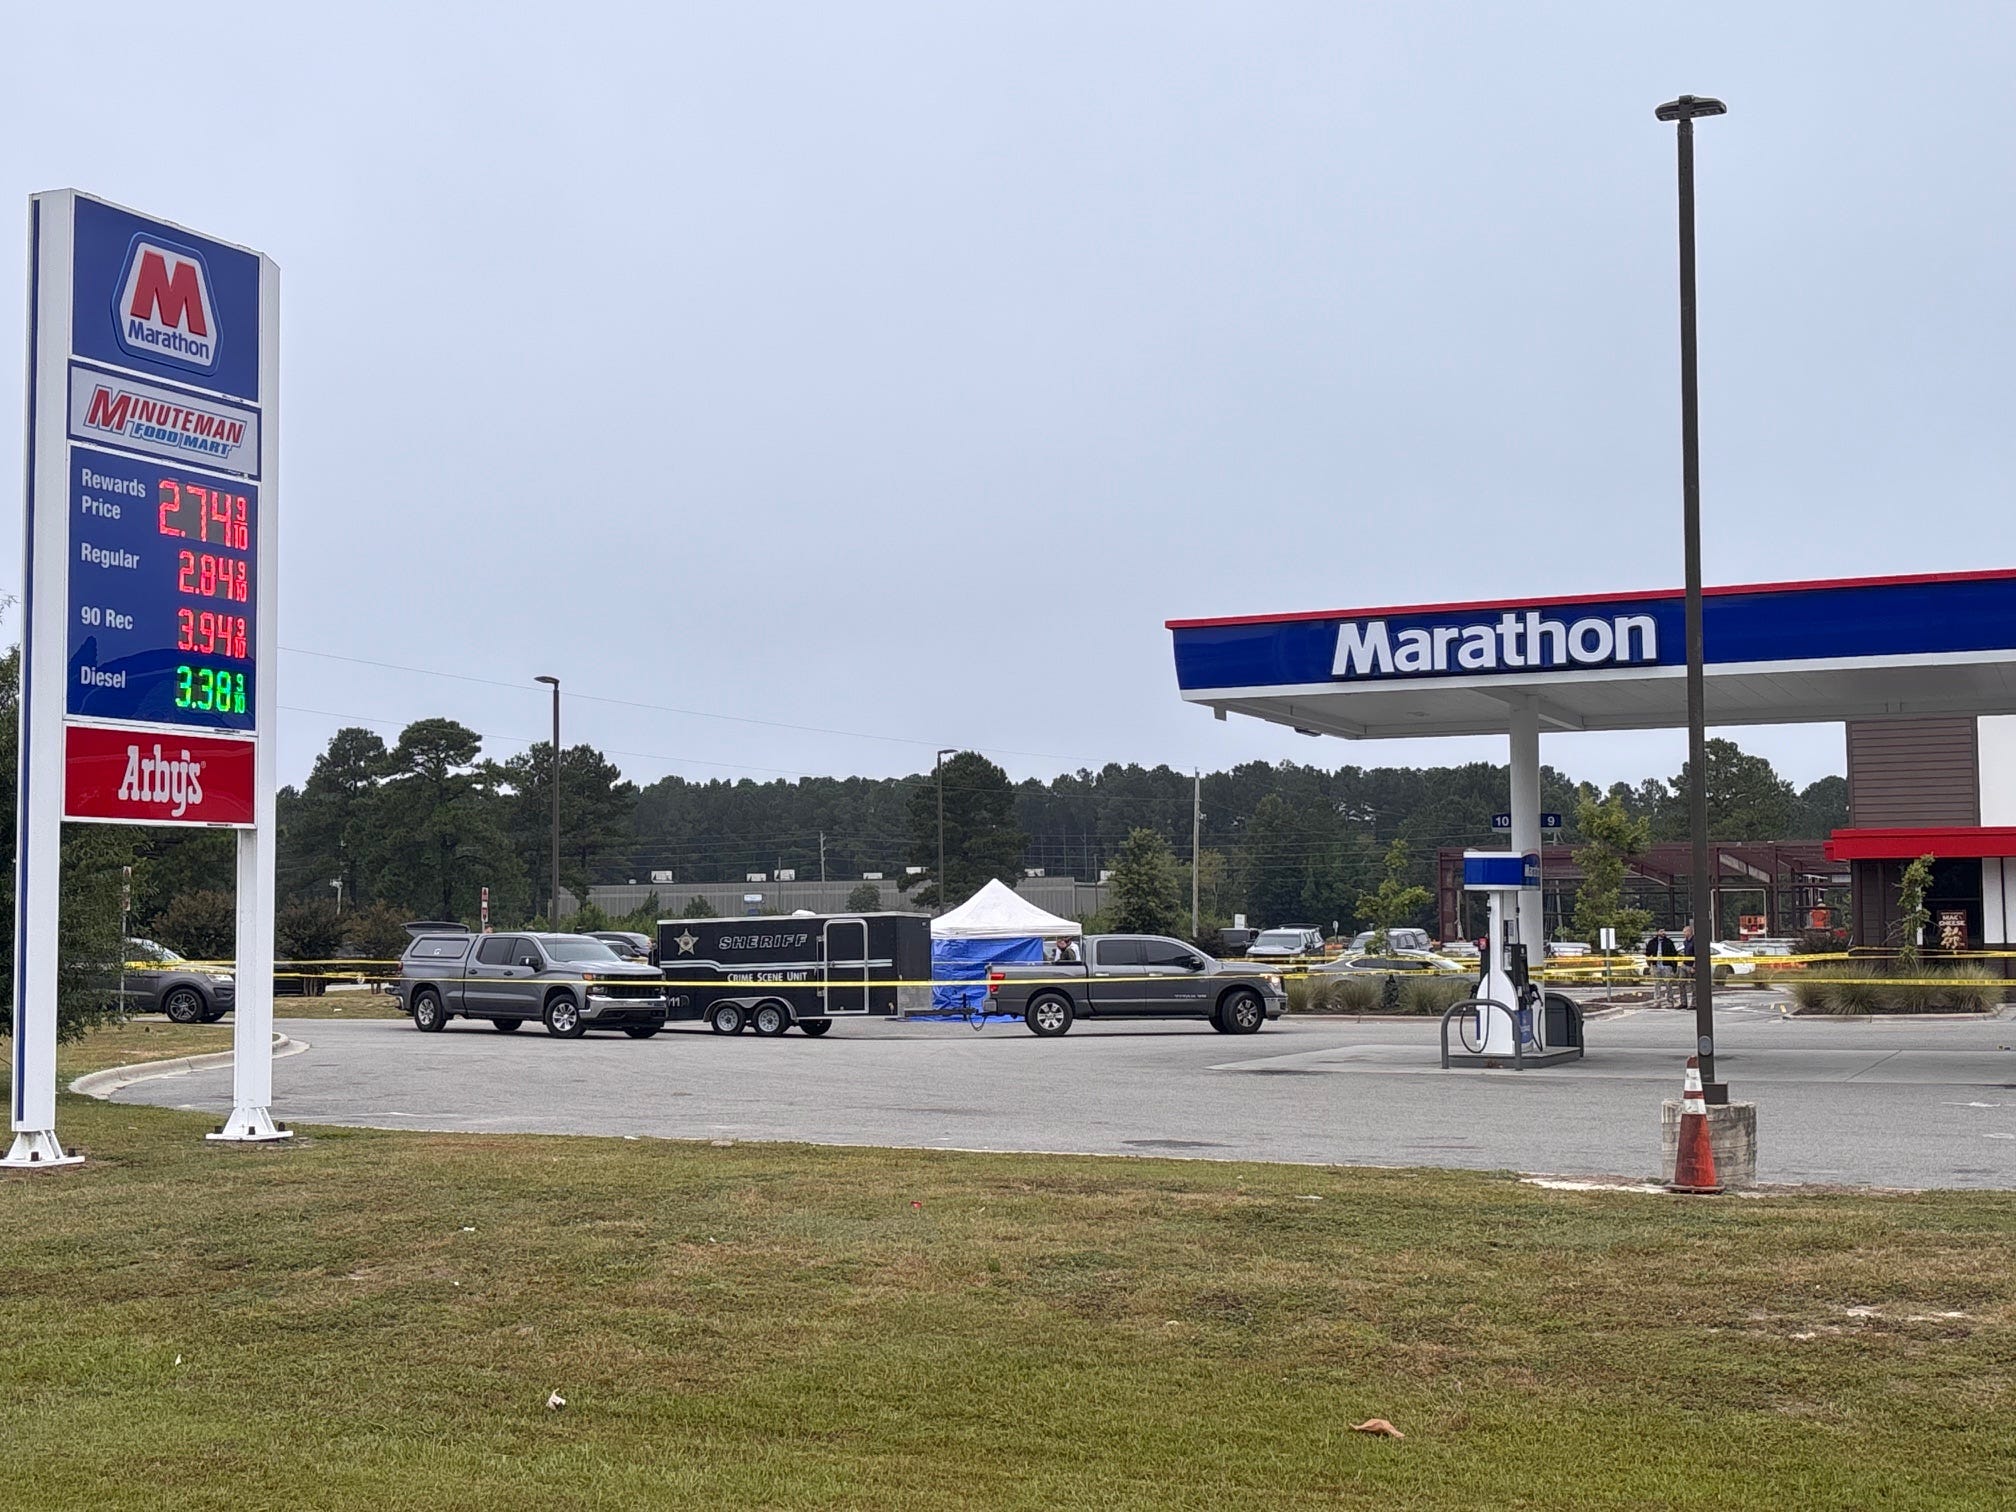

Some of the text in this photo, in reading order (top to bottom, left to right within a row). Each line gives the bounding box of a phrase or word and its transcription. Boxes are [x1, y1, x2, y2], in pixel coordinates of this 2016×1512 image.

[130, 250, 207, 337] M
[128, 319, 209, 360] Marathon
[88, 389, 244, 444] MINUTEMAN
[134, 422, 230, 455] FOOD MART
[81, 468, 147, 498] Rewards
[81, 495, 121, 519] Price
[159, 480, 232, 547] 2.74
[81, 542, 140, 569] Regular
[179, 550, 233, 600] 2.84
[81, 606, 134, 630] 90 Rec
[177, 608, 232, 657] 3.94
[1331, 612, 1658, 676] Marathon
[80, 666, 126, 689] Diesel
[175, 665, 231, 712] 3.38
[118, 744, 203, 817] Arby's
[1495, 816, 1510, 826] 10
[1547, 816, 1555, 826] 9
[719, 933, 808, 950] SHERIFF
[727, 971, 808, 983] CRIME SCENE UNIT
